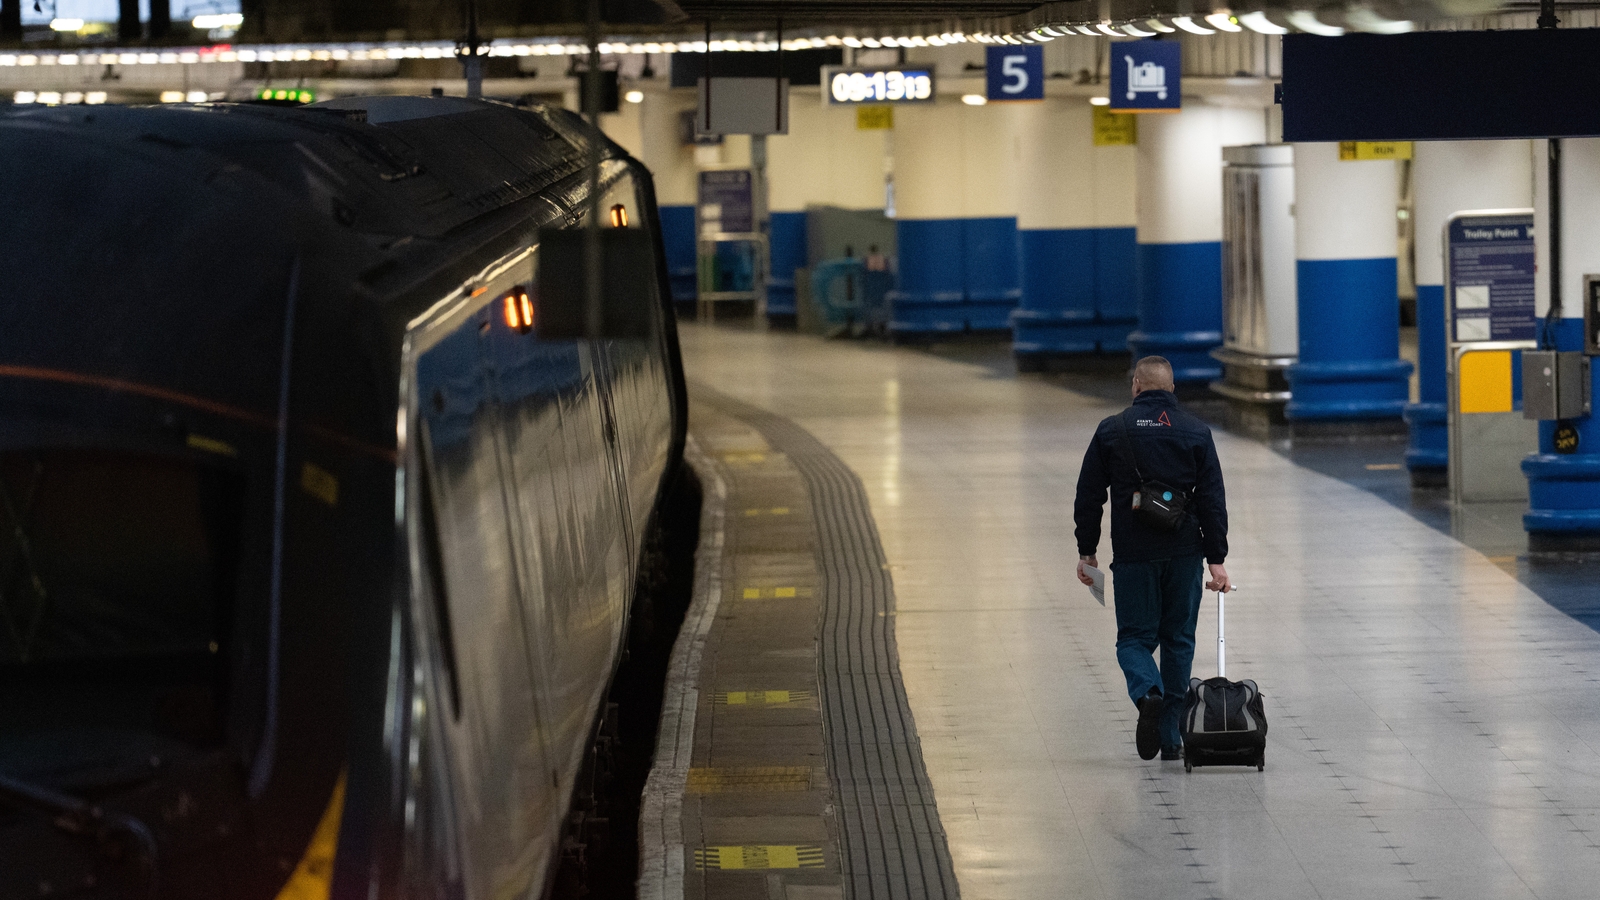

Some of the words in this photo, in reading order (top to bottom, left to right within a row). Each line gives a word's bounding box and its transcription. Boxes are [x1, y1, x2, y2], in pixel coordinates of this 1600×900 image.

[1002, 55, 1028, 93] 5
[1463, 229, 1493, 240] Trolley
[1495, 228, 1519, 239] Point
